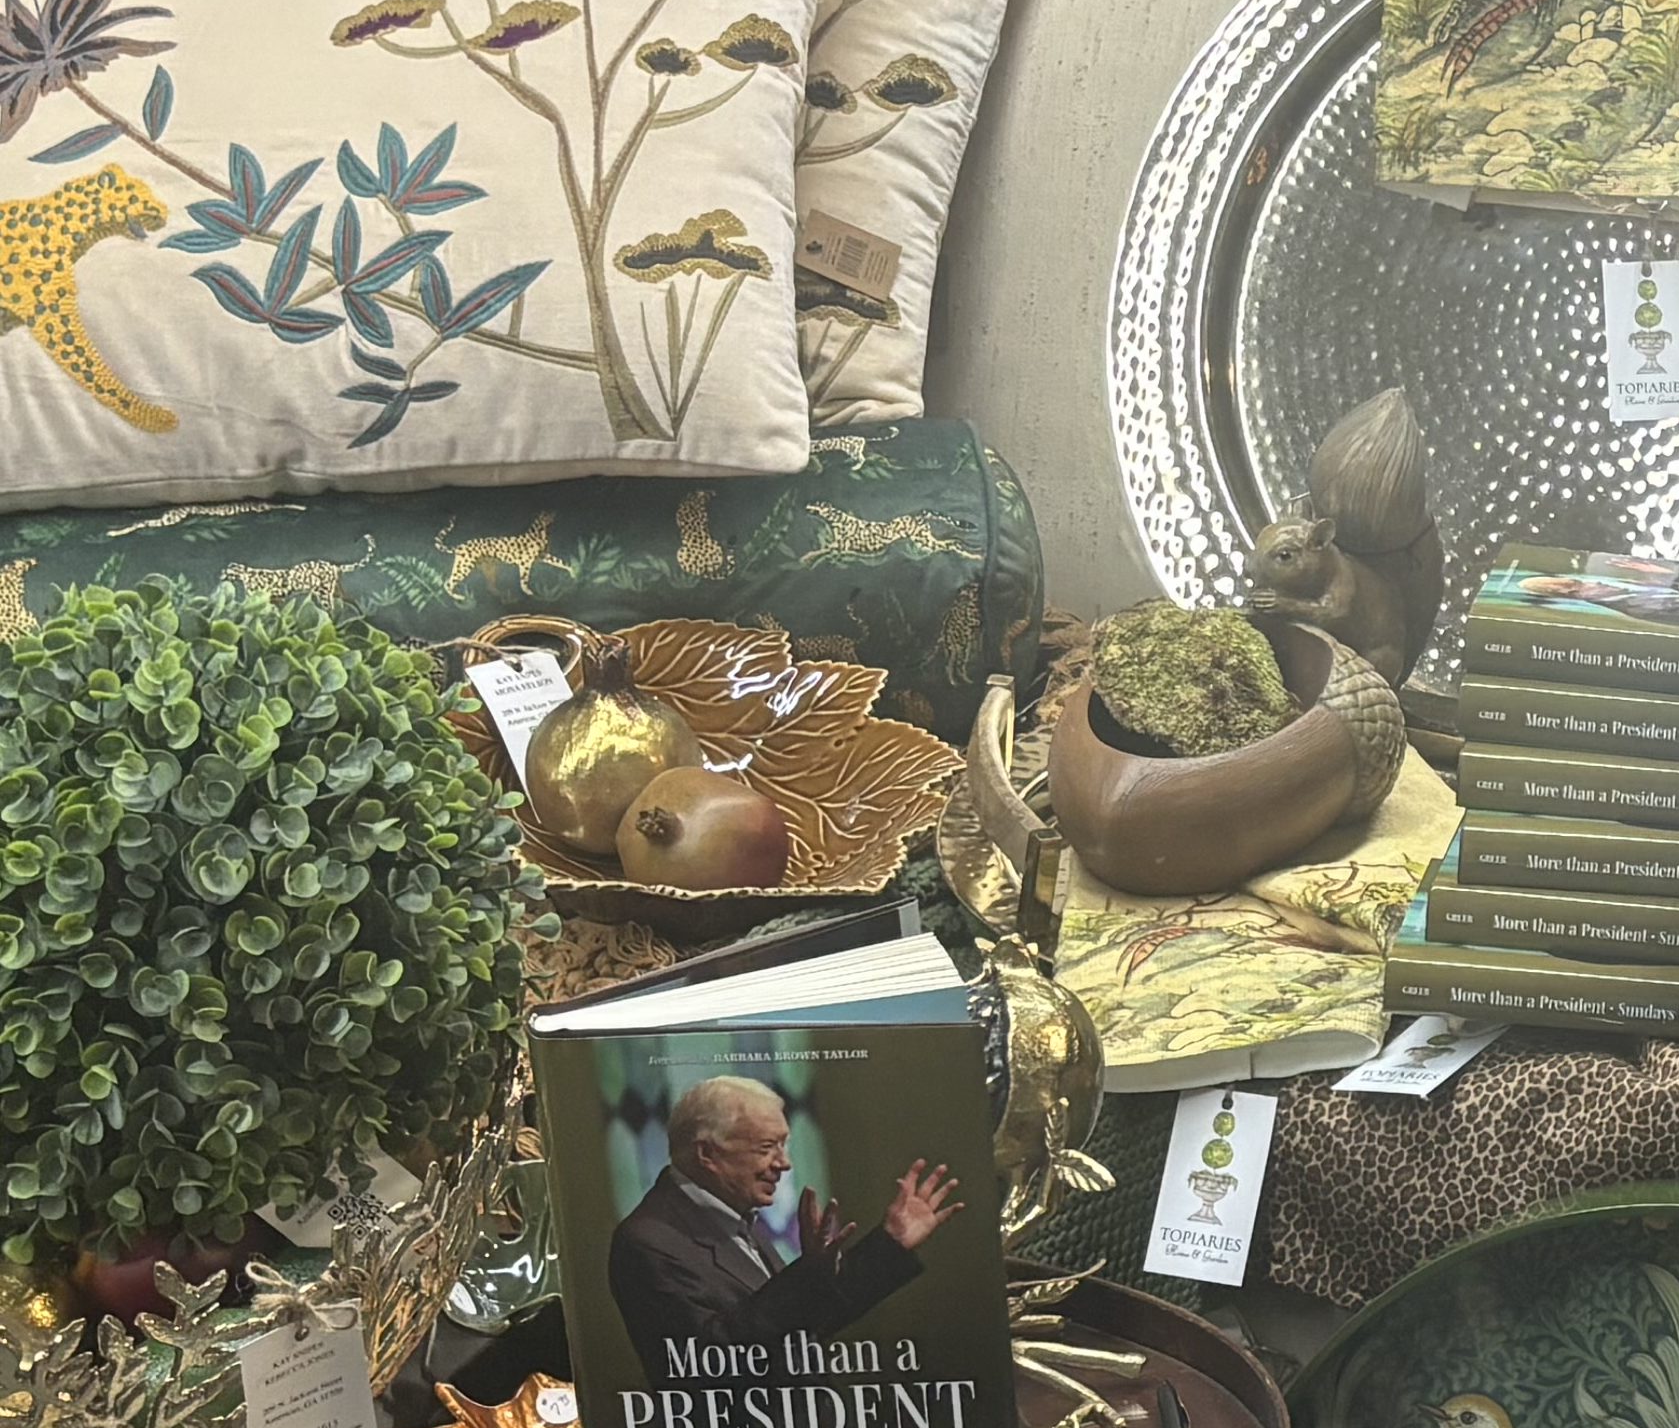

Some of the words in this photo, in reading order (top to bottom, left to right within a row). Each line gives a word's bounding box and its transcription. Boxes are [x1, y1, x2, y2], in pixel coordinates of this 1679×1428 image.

[1531, 645, 1567, 664] More
[1570, 649, 1601, 666] than
[1605, 656, 1613, 667] a
[1525, 712, 1561, 729] More
[1564, 716, 1596, 734] than
[1600, 723, 1608, 734] a
[1612, 721, 1677, 741] President
[1523, 781, 1559, 799] More
[1562, 785, 1595, 802] than
[1598, 792, 1607, 803] a
[1610, 789, 1676, 809] President
[1526, 854, 1562, 871] More
[1566, 857, 1598, 873] than
[1602, 864, 1610, 874] a
[1493, 914, 1529, 932] More
[1532, 918, 1565, 935] than
[1568, 925, 1576, 936] a
[1581, 923, 1647, 943] President
[1450, 987, 1486, 1005] More
[1489, 990, 1522, 1008] than
[1526, 998, 1534, 1009] a
[1539, 995, 1606, 1014] President
[1617, 1002, 1675, 1021] Sundays
[714, 1051, 771, 1063] BARBARA
[775, 1050, 820, 1061] BROWN
[822, 1049, 869, 1060] TAYLOR
[1160, 1227, 1242, 1252] TOPIARIES
[663, 1336, 769, 1379] More
[784, 1330, 880, 1375] than
[896, 1338, 920, 1372] a
